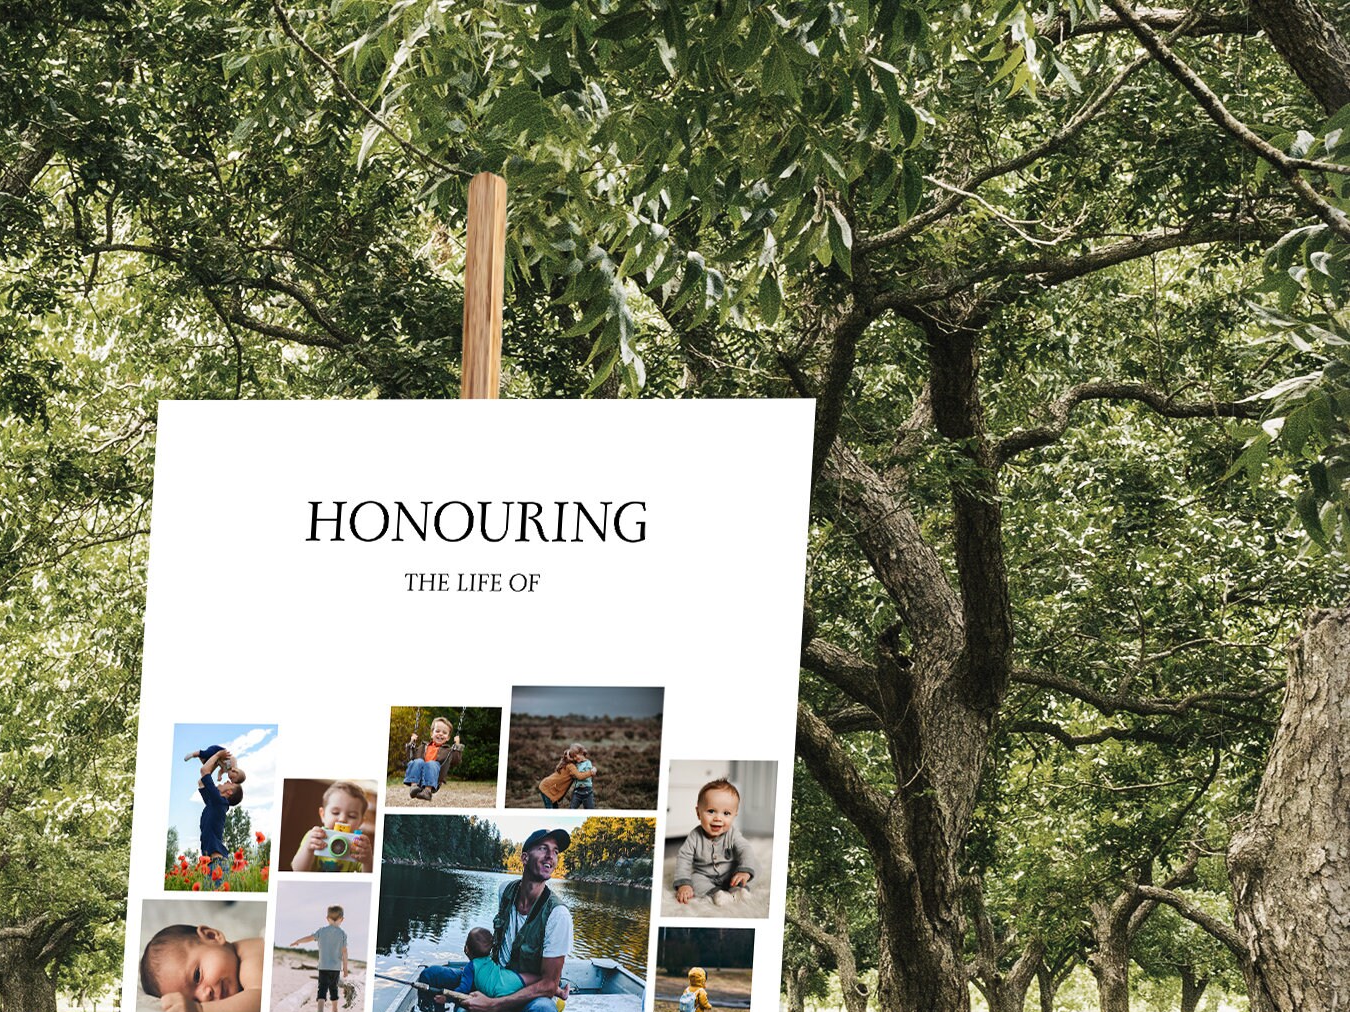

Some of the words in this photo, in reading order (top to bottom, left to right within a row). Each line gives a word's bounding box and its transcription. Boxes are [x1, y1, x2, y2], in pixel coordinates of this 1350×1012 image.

[304, 500, 648, 544] HONOURING
[403, 572, 451, 593] THE
[457, 572, 503, 593] LIFE
[508, 572, 542, 593] OF
